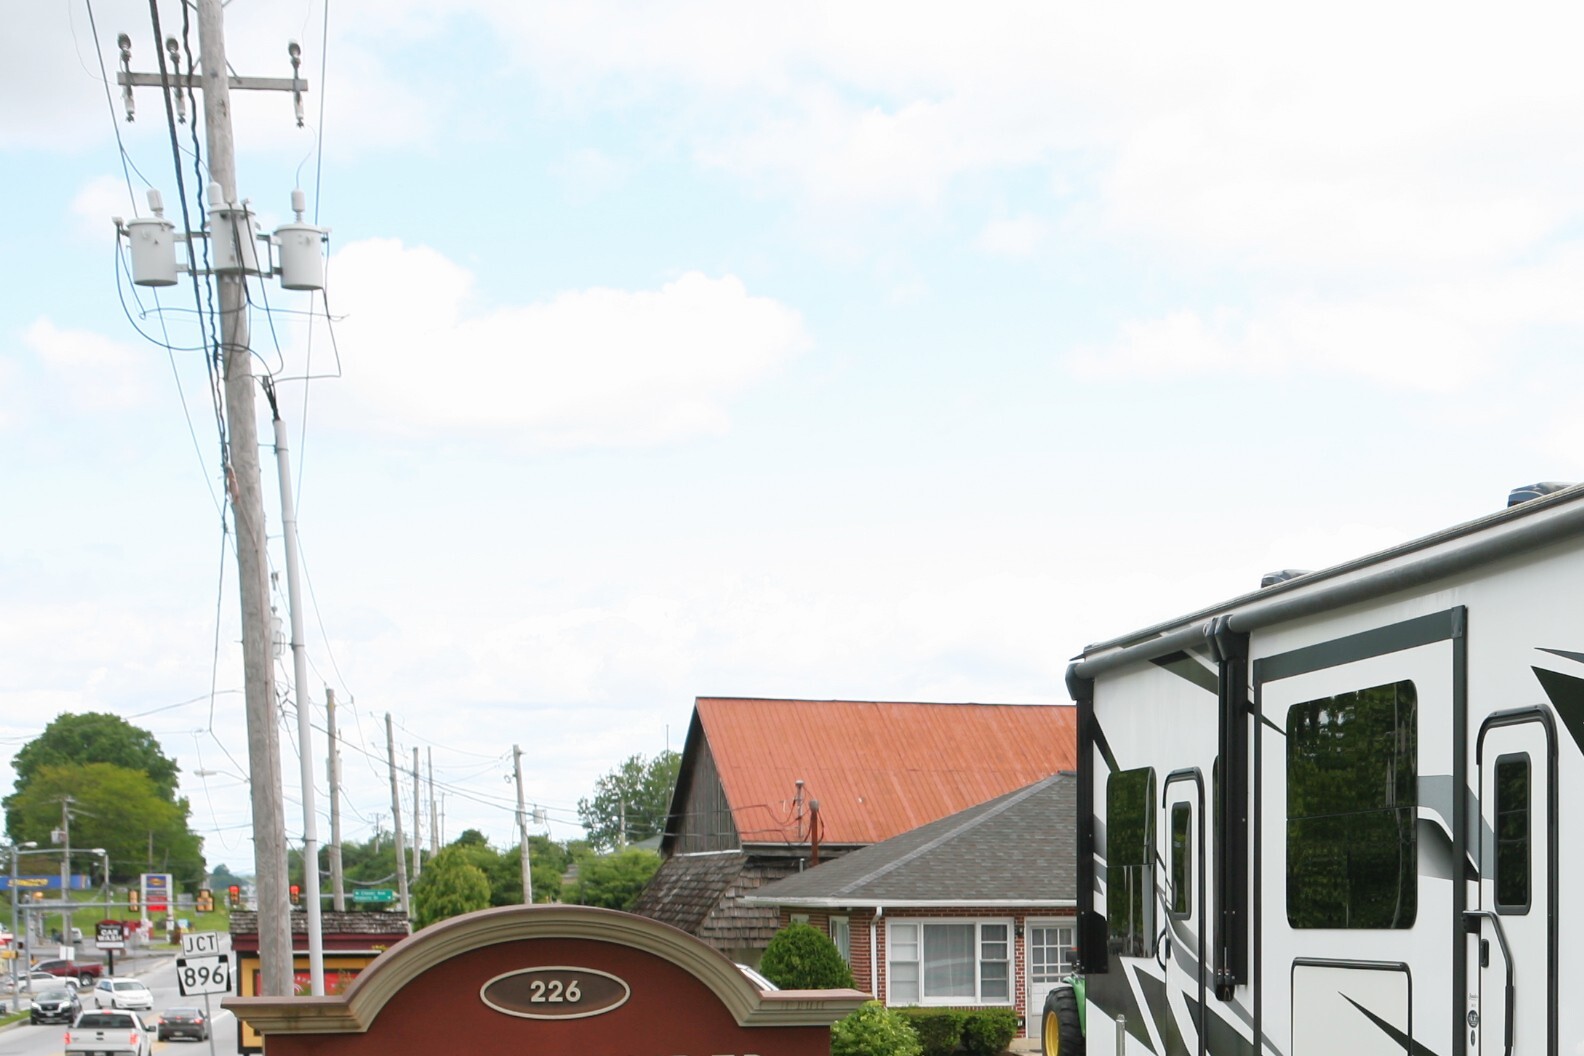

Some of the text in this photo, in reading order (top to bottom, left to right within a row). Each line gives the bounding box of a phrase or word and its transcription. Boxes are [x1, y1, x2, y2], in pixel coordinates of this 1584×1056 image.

[186, 935, 215, 953] JCT
[184, 966, 225, 988] 896
[530, 980, 582, 1002] 226
